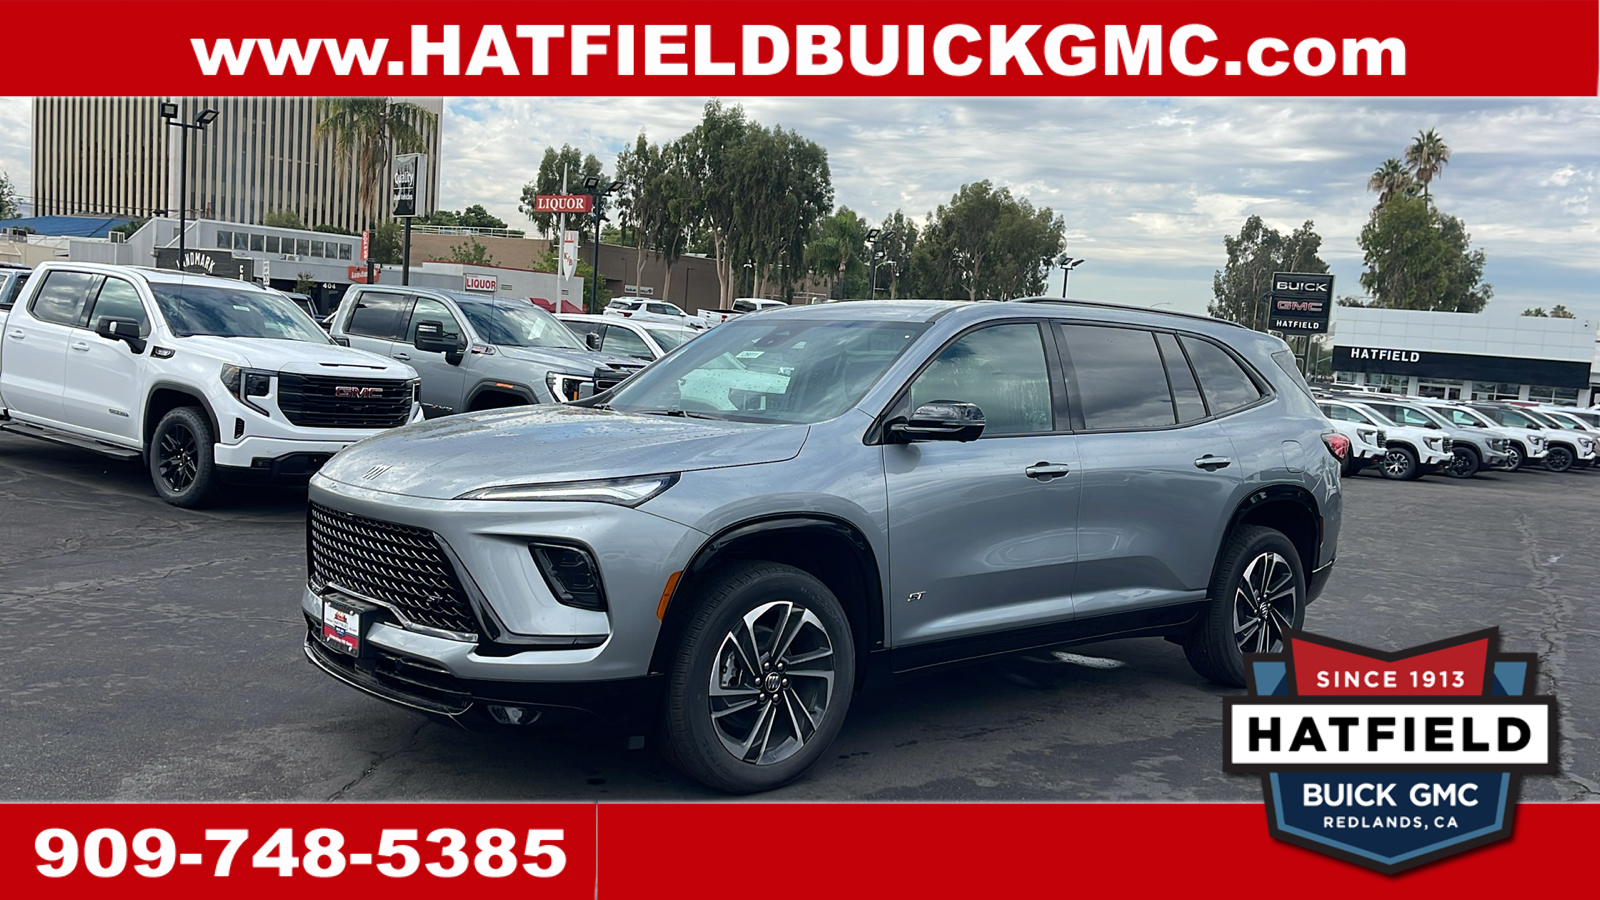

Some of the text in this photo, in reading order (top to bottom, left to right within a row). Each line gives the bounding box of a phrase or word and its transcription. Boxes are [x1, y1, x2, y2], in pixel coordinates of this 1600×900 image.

[538, 198, 584, 211] LIQUOR
[466, 278, 496, 290] LIQUOR
[1276, 281, 1328, 292] BUICK
[1277, 301, 1323, 312] GMC
[1276, 320, 1320, 330] HATFIELD
[1350, 347, 1420, 363] HATFIELD
[335, 386, 383, 398] GMC
